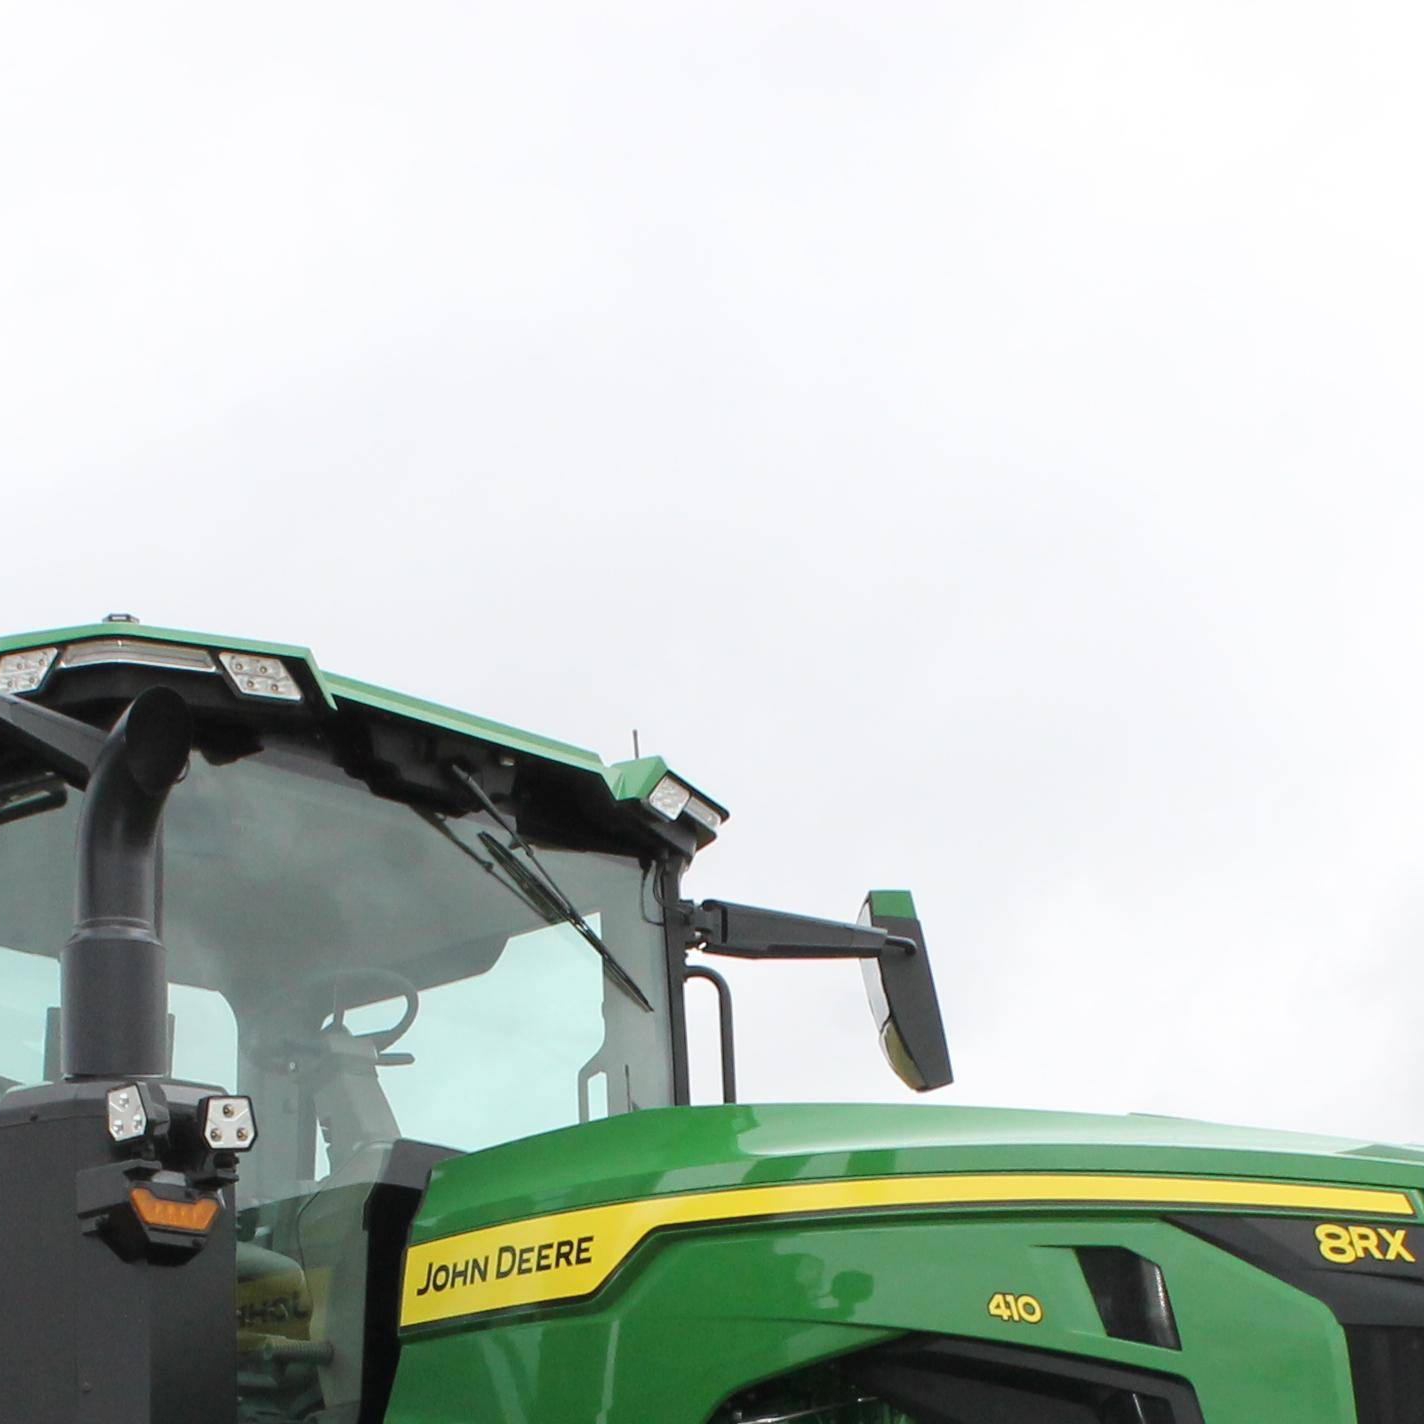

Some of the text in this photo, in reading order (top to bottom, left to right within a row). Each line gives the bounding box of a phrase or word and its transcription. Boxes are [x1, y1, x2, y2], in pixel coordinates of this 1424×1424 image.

[1314, 1223, 1416, 1264] 8RX
[416, 1235, 594, 1297] JOHN DEERE
[987, 1292, 1043, 1325] 410
